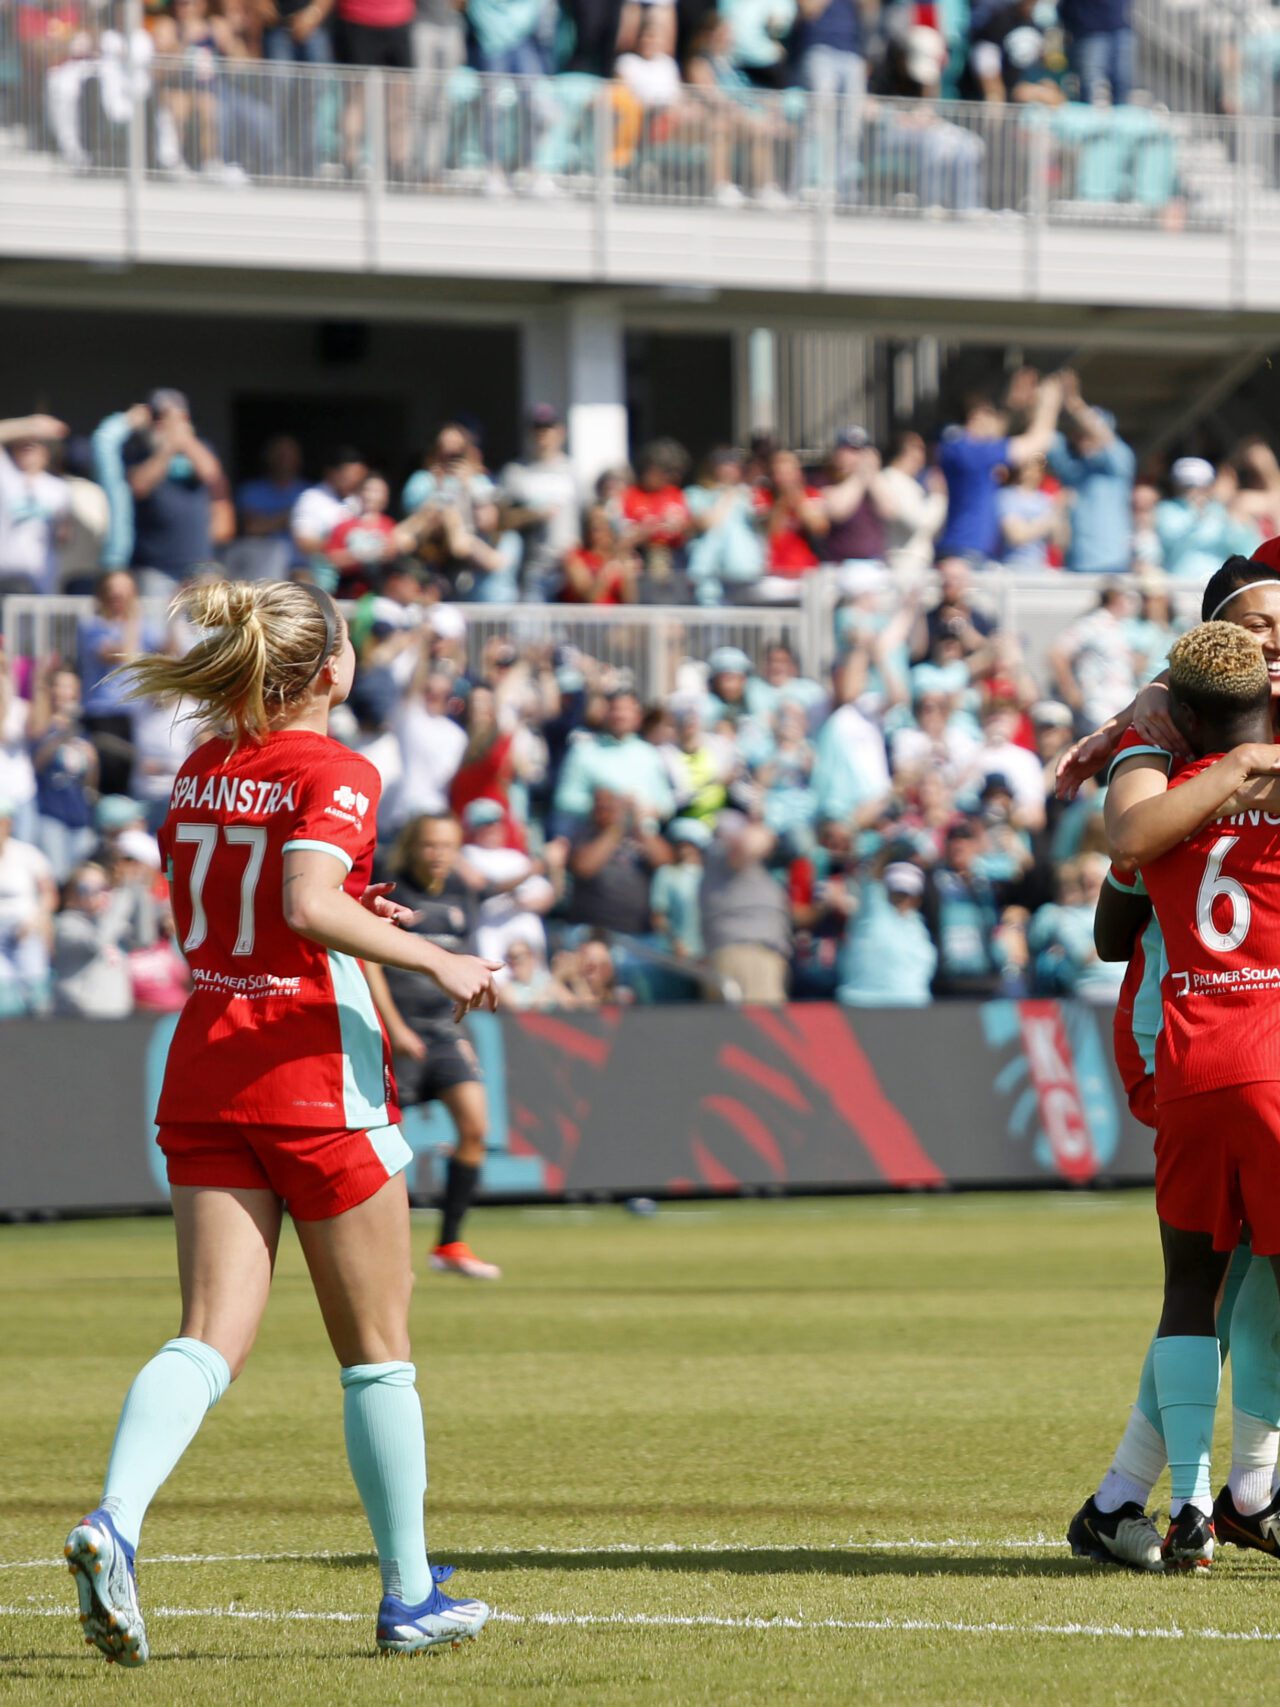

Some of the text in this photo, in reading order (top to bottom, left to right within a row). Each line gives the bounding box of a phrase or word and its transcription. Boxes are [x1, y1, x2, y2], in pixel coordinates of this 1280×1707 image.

[171, 775, 297, 814] SPAANSTRA
[176, 823, 267, 956] 77
[1196, 836, 1250, 952] 6
